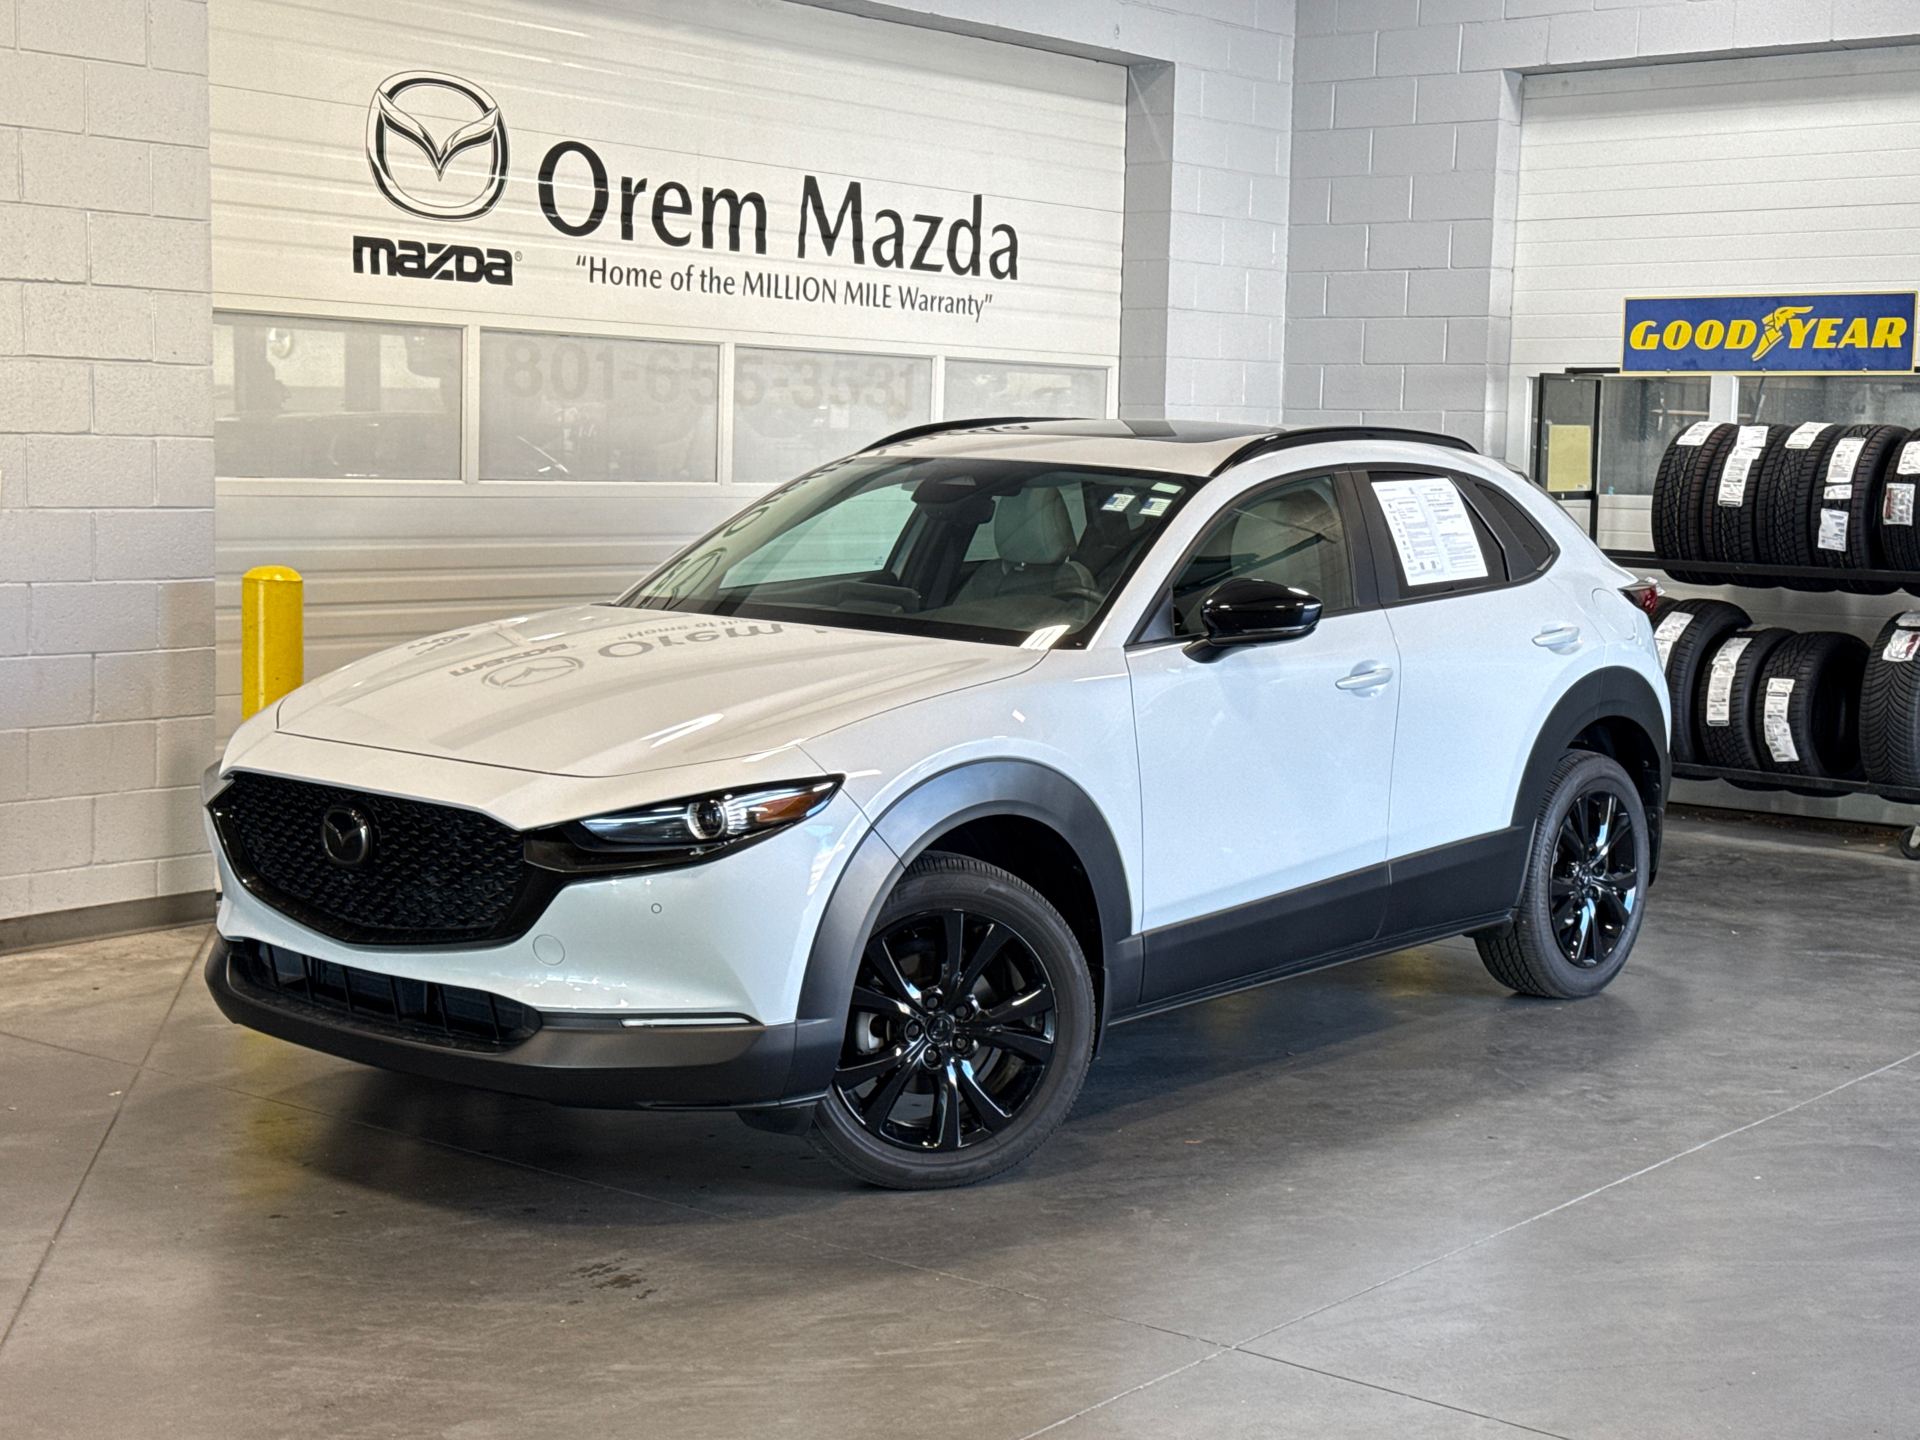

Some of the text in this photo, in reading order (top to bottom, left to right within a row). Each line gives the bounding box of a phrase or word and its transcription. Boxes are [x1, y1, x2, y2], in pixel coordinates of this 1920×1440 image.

[538, 141, 1018, 280] Orem Mazda
[353, 235, 514, 286] mazda
[670, 264, 695, 292] of
[700, 267, 735, 296] the
[743, 271, 837, 304] MILLION
[844, 280, 893, 309] MILE
[503, 338, 915, 412] 801-655-3531
